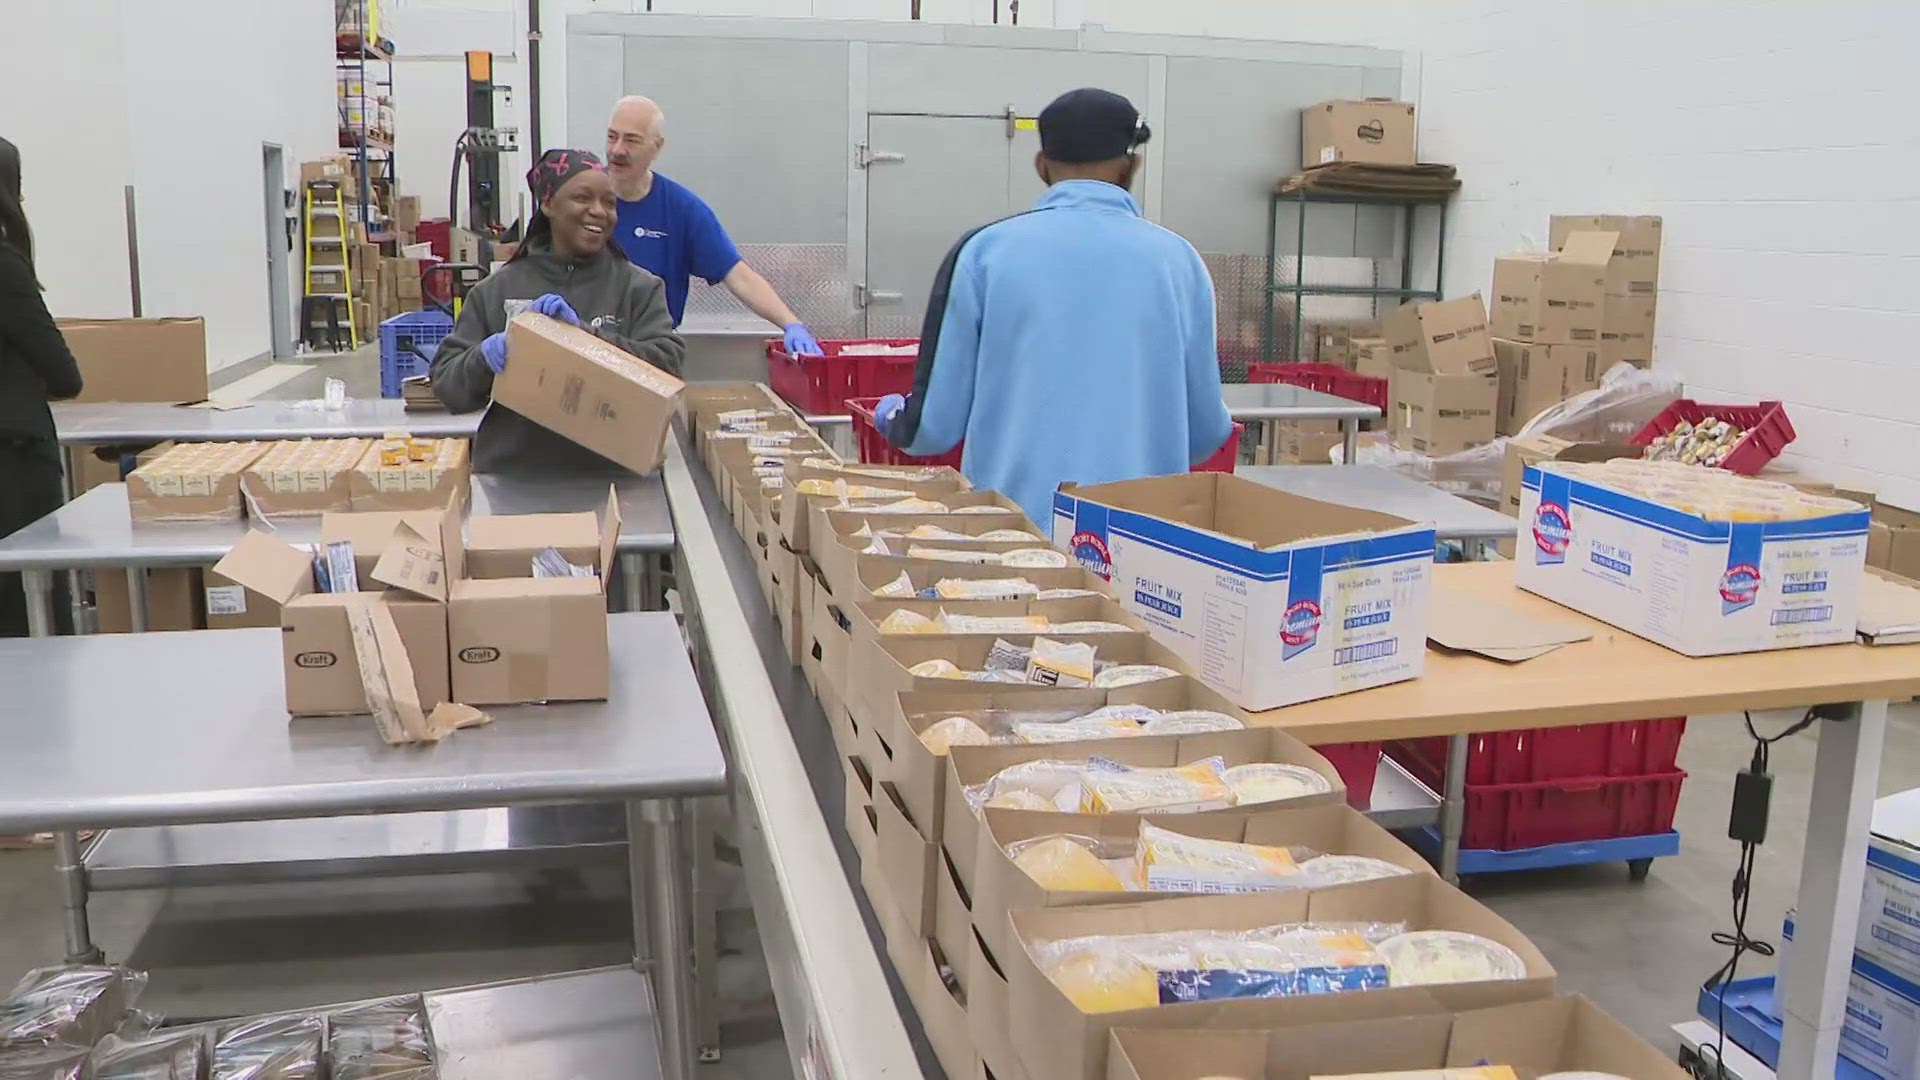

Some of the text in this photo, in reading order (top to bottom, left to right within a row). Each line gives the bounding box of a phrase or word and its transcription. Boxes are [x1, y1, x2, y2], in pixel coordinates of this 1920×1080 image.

[1591, 539, 1616, 555] FRUIT
[1136, 576, 1183, 603] FRUIT MIX
[1344, 599, 1392, 616] FRUIT MIX
[303, 654, 328, 665] Kraft
[466, 651, 491, 661] Kraft
